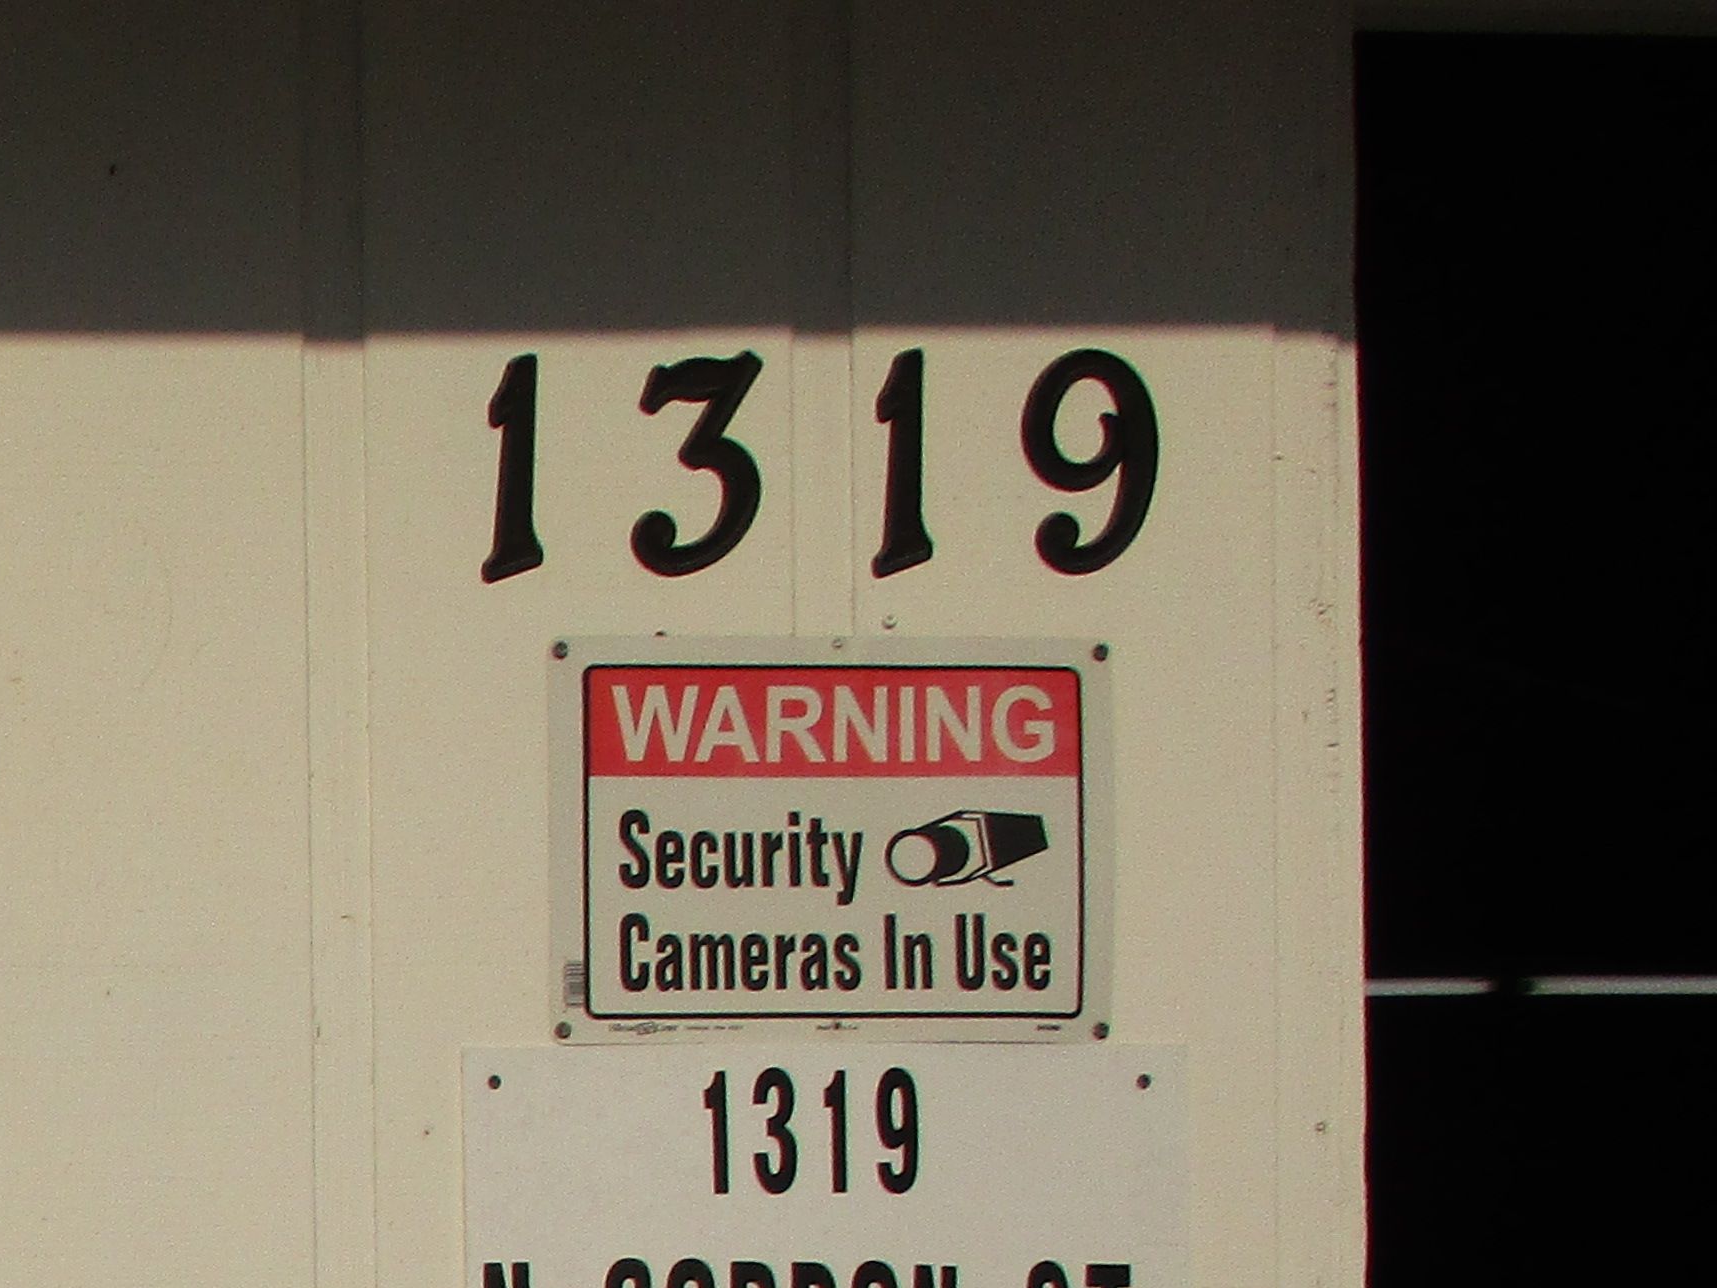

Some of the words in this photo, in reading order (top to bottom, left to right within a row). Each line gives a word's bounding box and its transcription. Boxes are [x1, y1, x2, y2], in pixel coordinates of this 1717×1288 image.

[481, 348, 1159, 584] 1319
[611, 684, 1055, 764] WARNING
[619, 809, 864, 905] Security
[619, 912, 862, 991] Cameras
[884, 913, 933, 990] In
[955, 913, 1051, 991] Use
[703, 1067, 919, 1195] 1319
